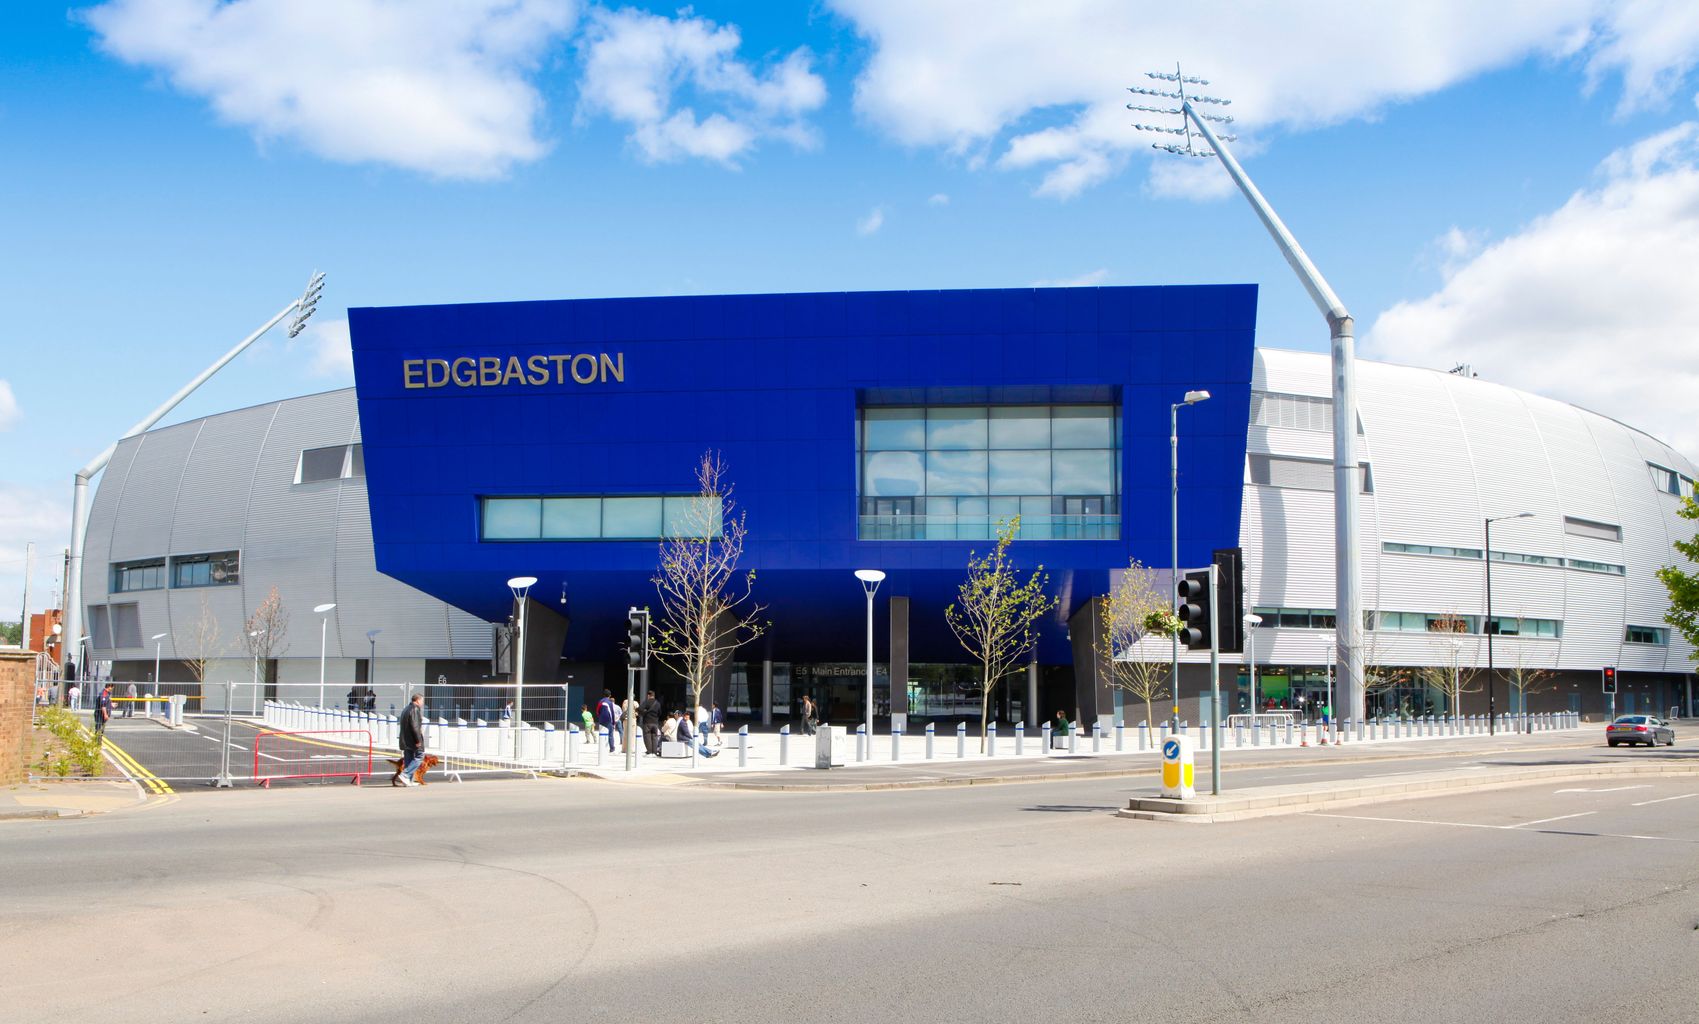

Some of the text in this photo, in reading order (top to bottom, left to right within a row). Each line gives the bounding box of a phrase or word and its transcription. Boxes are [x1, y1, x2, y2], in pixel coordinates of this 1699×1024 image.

[403, 352, 624, 389] EDGBASTON
[812, 667, 832, 676] Main
[833, 667, 869, 676] Entranc
[876, 667, 887, 676] E4
